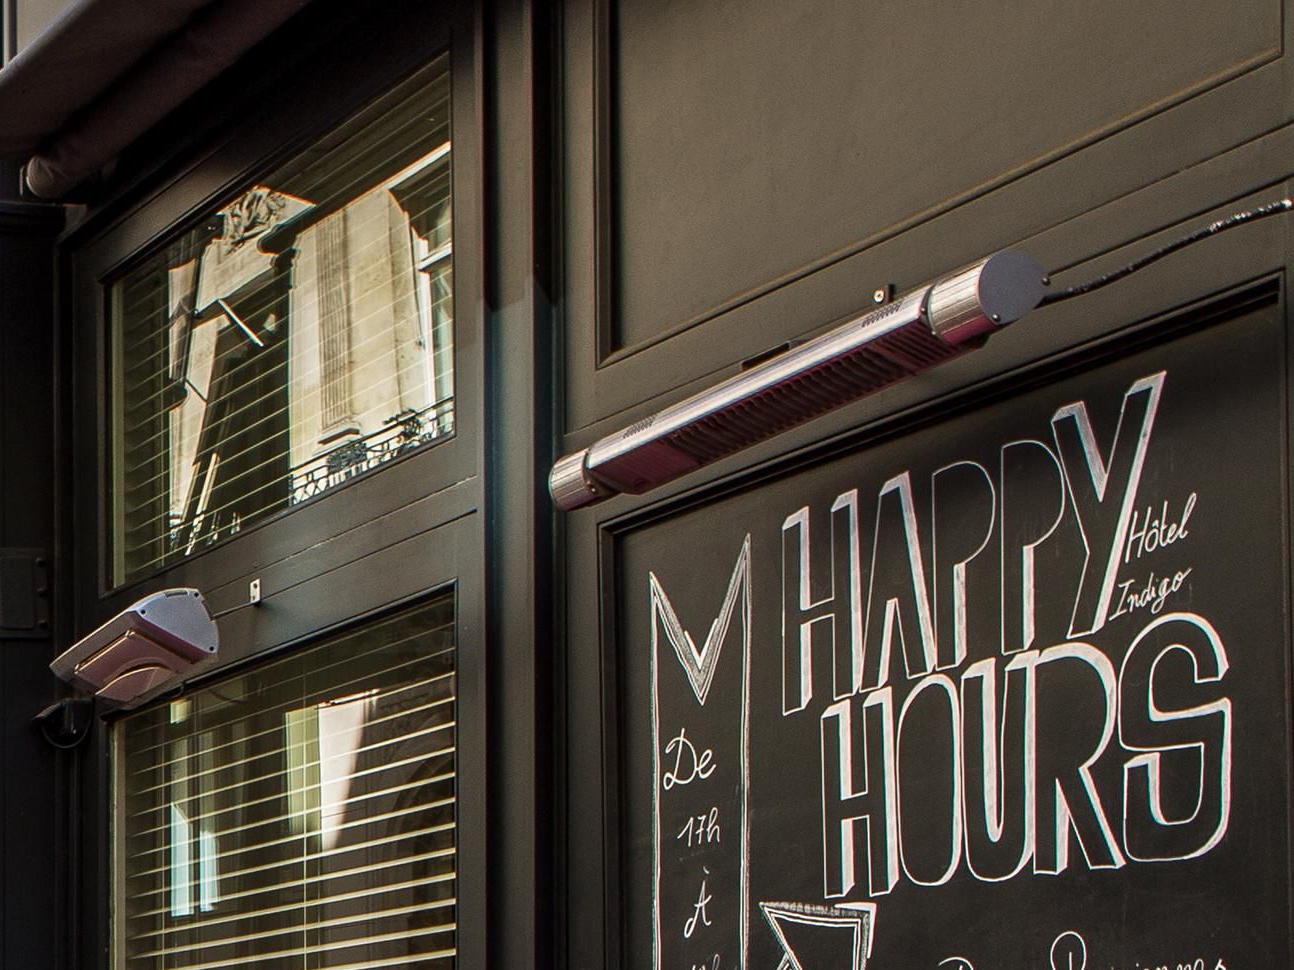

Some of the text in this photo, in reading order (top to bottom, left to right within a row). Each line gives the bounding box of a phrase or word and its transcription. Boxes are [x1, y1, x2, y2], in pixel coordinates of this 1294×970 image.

[782, 371, 1167, 716] HAPPY
[1125, 492, 1197, 563] Hôtel
[1109, 568, 1192, 621] Indigo
[663, 728, 717, 790] De
[820, 612, 1232, 899] HOURS
[677, 807, 720, 849] 17h
